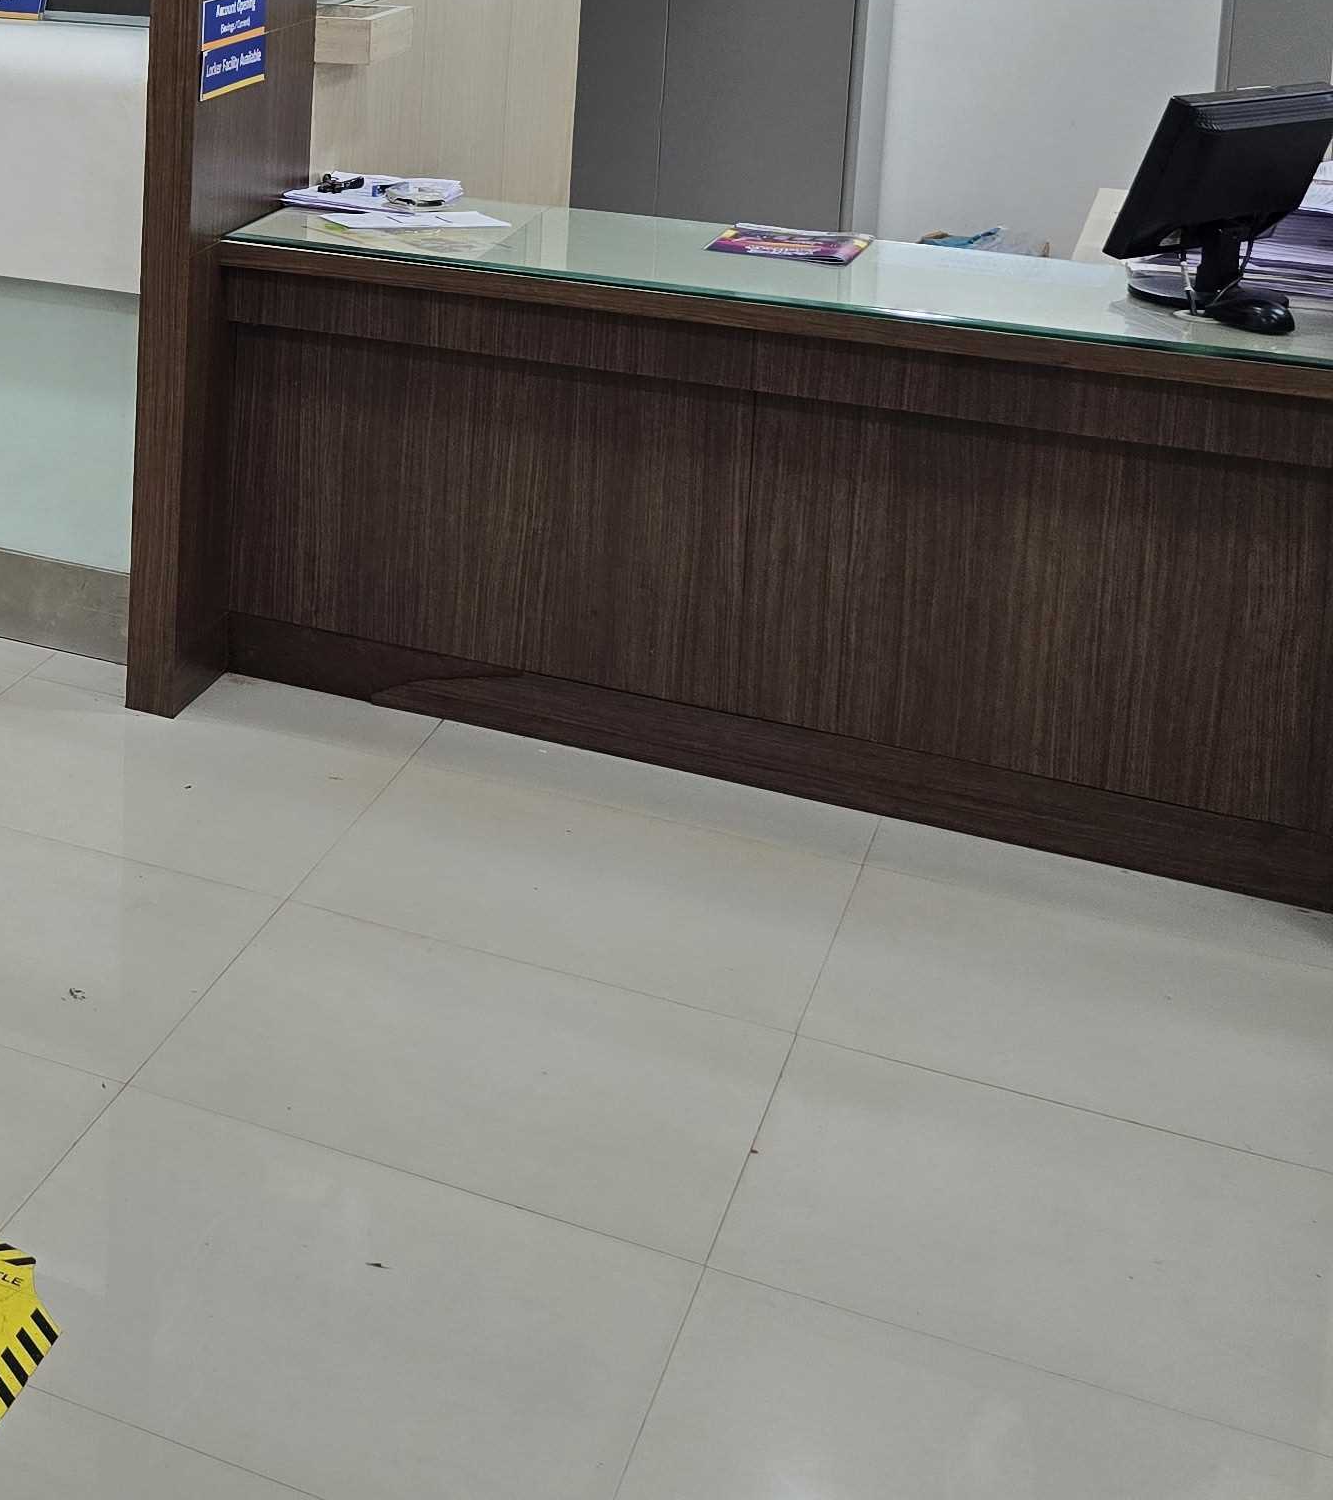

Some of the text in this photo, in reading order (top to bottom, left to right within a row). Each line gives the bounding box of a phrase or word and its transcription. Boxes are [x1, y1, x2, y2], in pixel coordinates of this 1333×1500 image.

[215, 1, 237, 18] Account
[205, 48, 262, 78] Locker Facility Available
